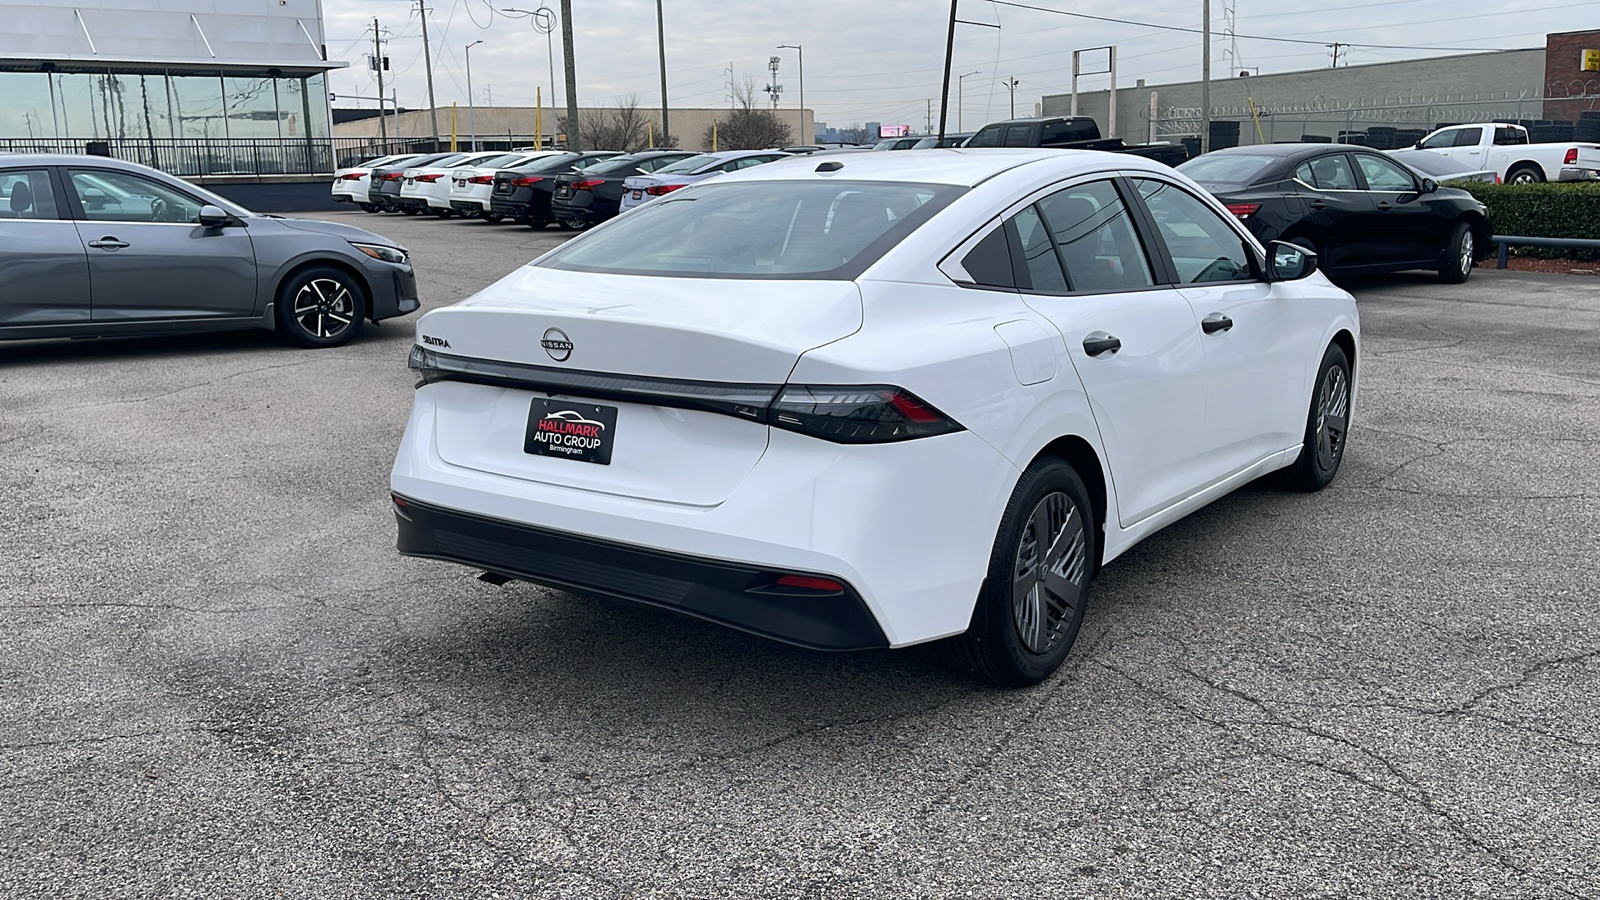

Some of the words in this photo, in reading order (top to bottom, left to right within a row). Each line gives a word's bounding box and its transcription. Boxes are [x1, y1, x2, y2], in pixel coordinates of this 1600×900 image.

[541, 341, 572, 349] NISSAN
[538, 419, 600, 438] HALLMARK
[533, 431, 562, 444] AUTO
[564, 434, 601, 449] GROUP
[549, 444, 583, 455] Birmingham
